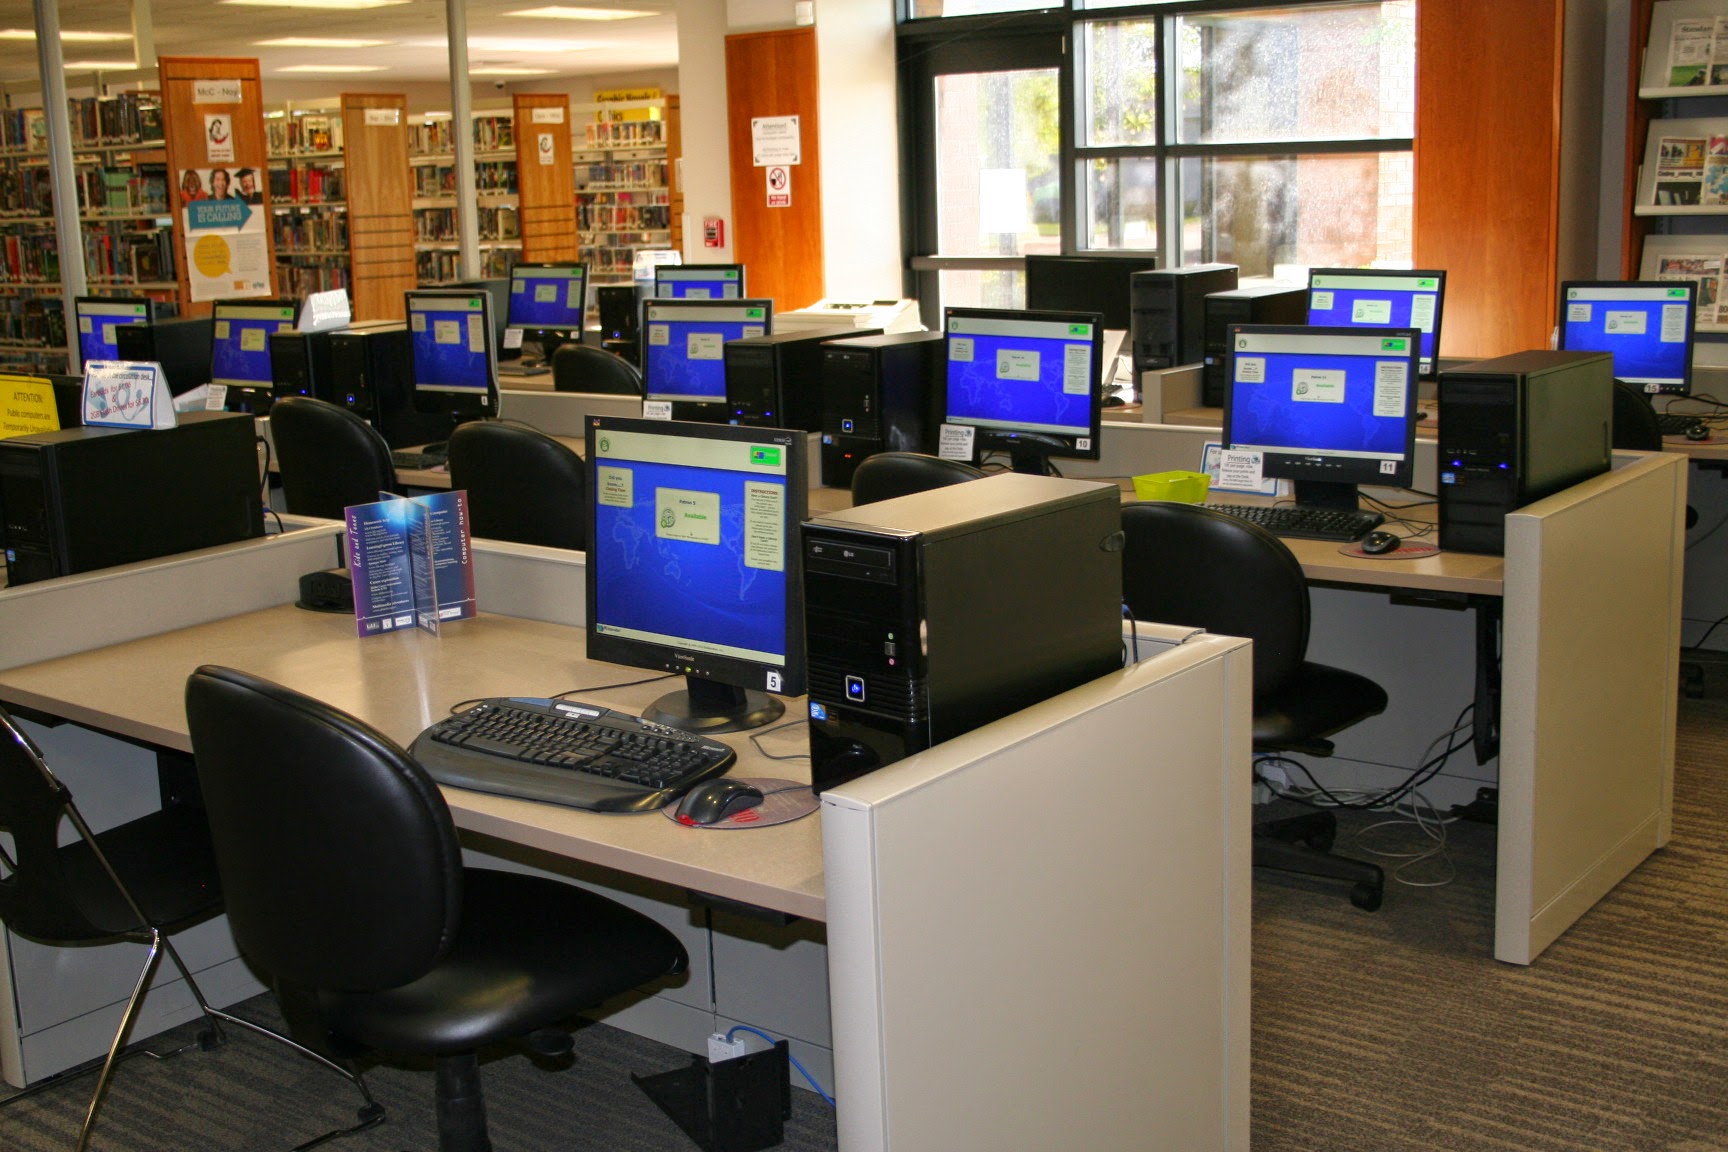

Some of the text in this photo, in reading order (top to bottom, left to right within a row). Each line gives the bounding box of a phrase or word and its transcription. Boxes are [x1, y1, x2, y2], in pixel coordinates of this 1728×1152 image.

[197, 88, 216, 96] McC
[197, 203, 241, 214] YOUR FUTURE
[197, 211, 242, 223] IS CALLING
[1079, 440, 1087, 448] 10
[1227, 455, 1250, 463] Printing
[1383, 462, 1393, 472] 11
[751, 488, 778, 496] INSTRUCTIONS
[684, 512, 707, 520] Available
[457, 498, 468, 565] Computer how-to
[674, 652, 695, 662] ViewSonic
[770, 676, 777, 688] 5
